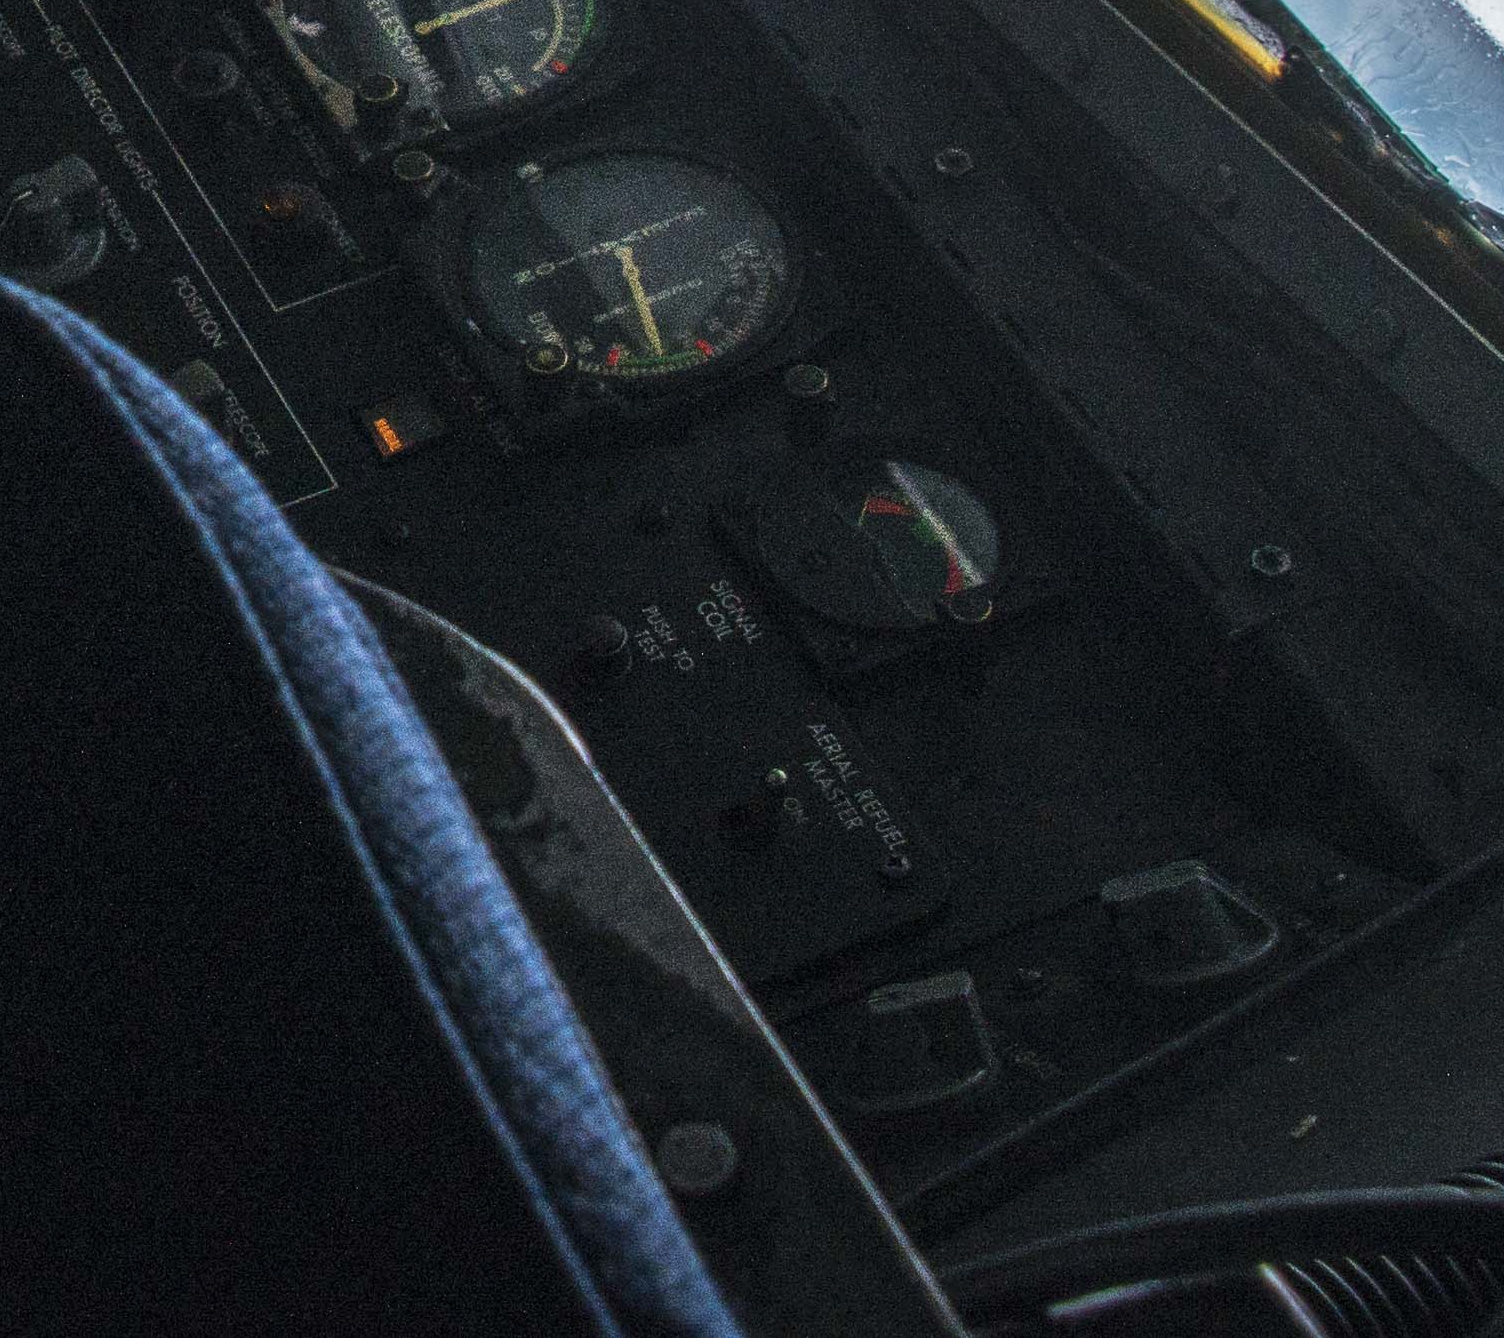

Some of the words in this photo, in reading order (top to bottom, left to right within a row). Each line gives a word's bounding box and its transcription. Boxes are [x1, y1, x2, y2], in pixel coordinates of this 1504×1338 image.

[44, 25, 78, 60] PILOT
[69, 67, 122, 133] DIRECTOR
[115, 140, 157, 190] LIGHTS
[170, 277, 227, 347] POSITION
[219, 391, 270, 457] TELESCOPE
[641, 607, 676, 641] PUSH
[671, 651, 696, 670] TO
[695, 602, 733, 636] COIL
[708, 582, 763, 639] SIGNAL
[633, 632, 665, 660] TEST
[780, 797, 810, 823] ON
[802, 760, 863, 828] MASTER
[806, 722, 858, 777] AERIAL
[852, 791, 907, 848] REFUEL
